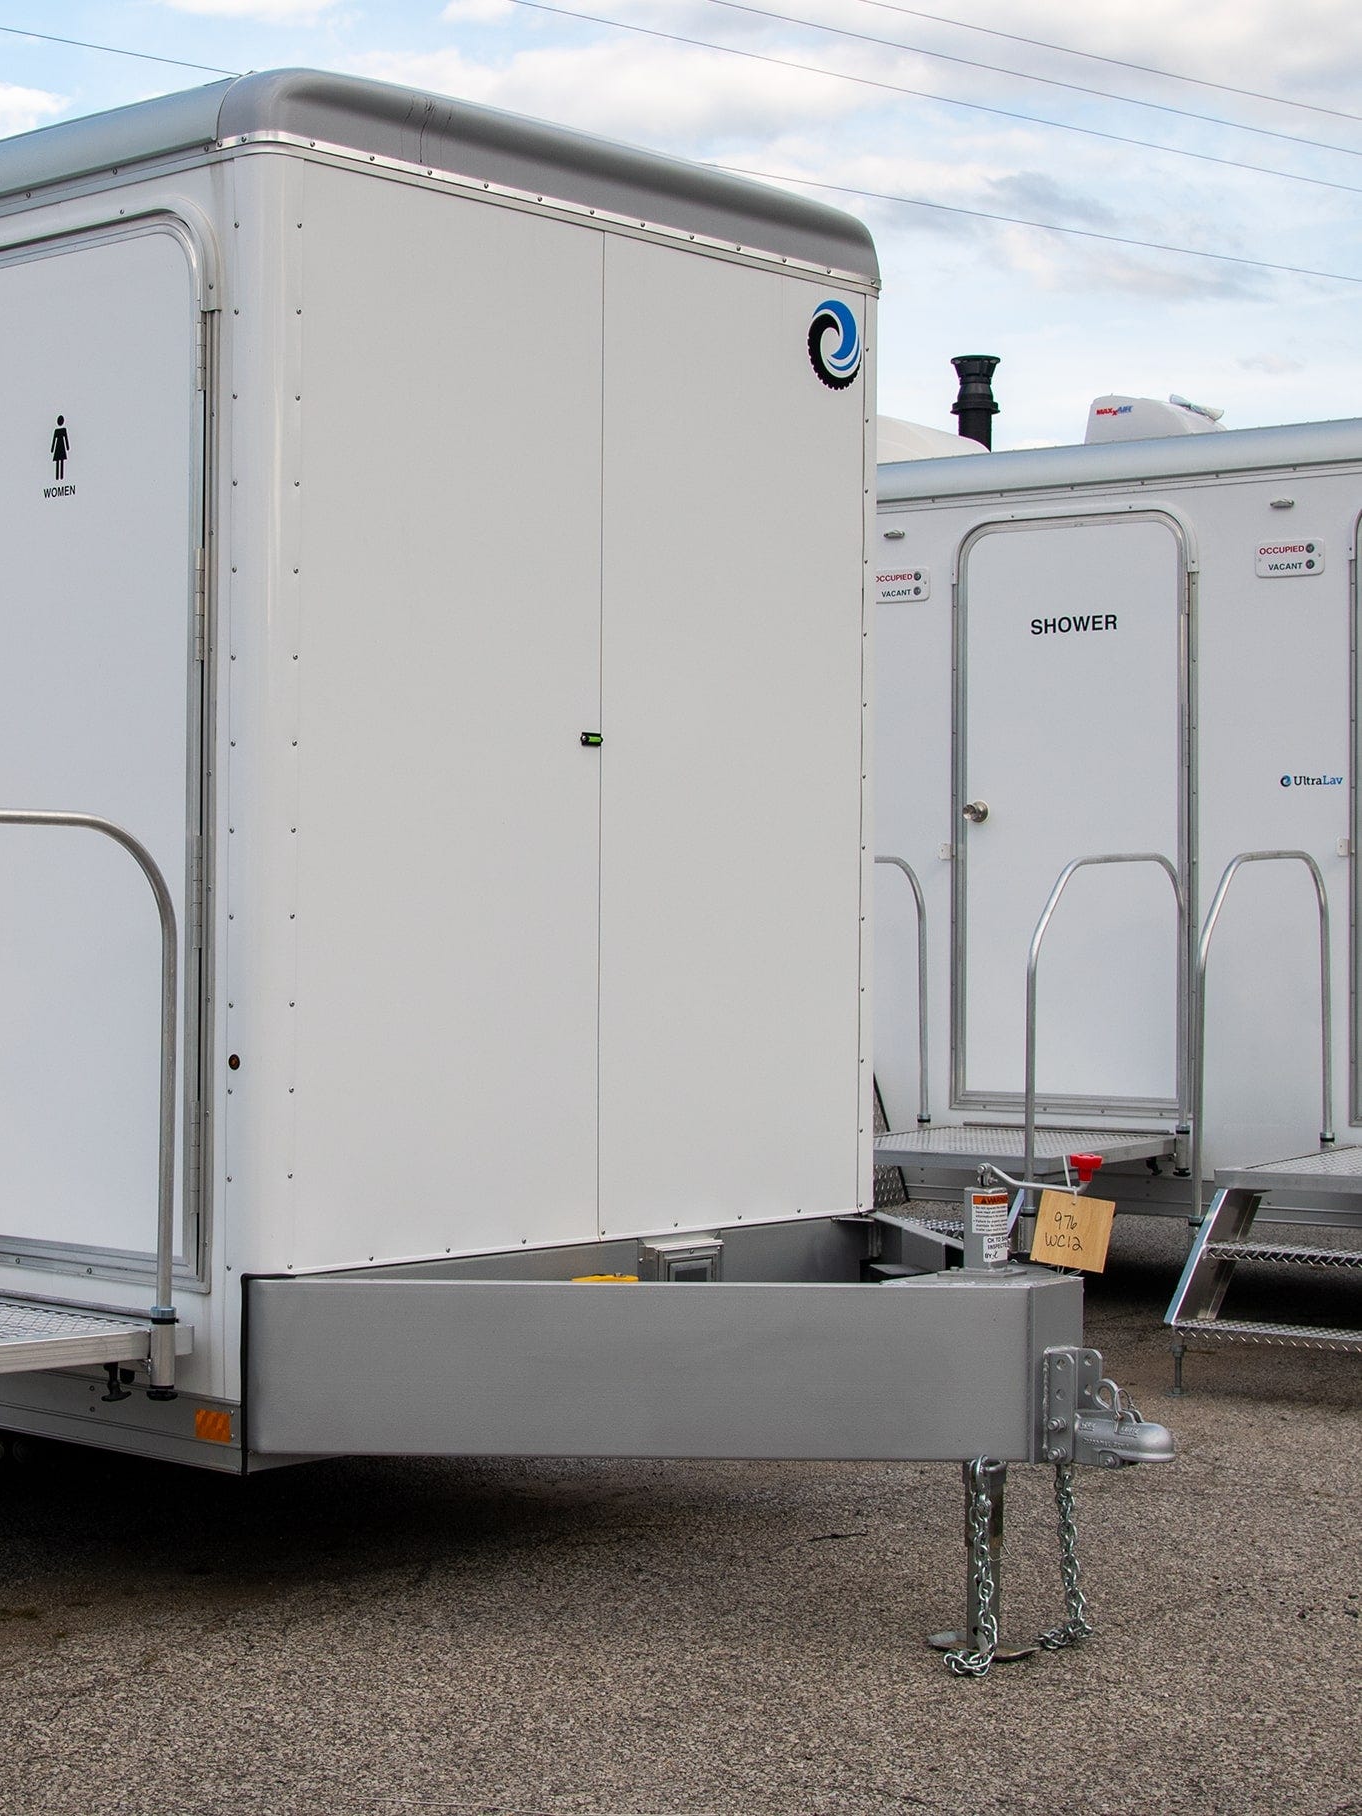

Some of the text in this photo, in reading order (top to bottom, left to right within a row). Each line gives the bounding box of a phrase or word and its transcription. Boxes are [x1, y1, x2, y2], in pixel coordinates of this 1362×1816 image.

[43, 485, 76, 498] WOMEN
[1259, 545, 1305, 555] OCCUPIED
[1268, 562, 1302, 571] VACANT
[881, 589, 911, 598] VACANT
[1030, 614, 1118, 635] SHOWER
[1293, 775, 1343, 786] UltraLav
[1054, 1211, 1078, 1230] 976
